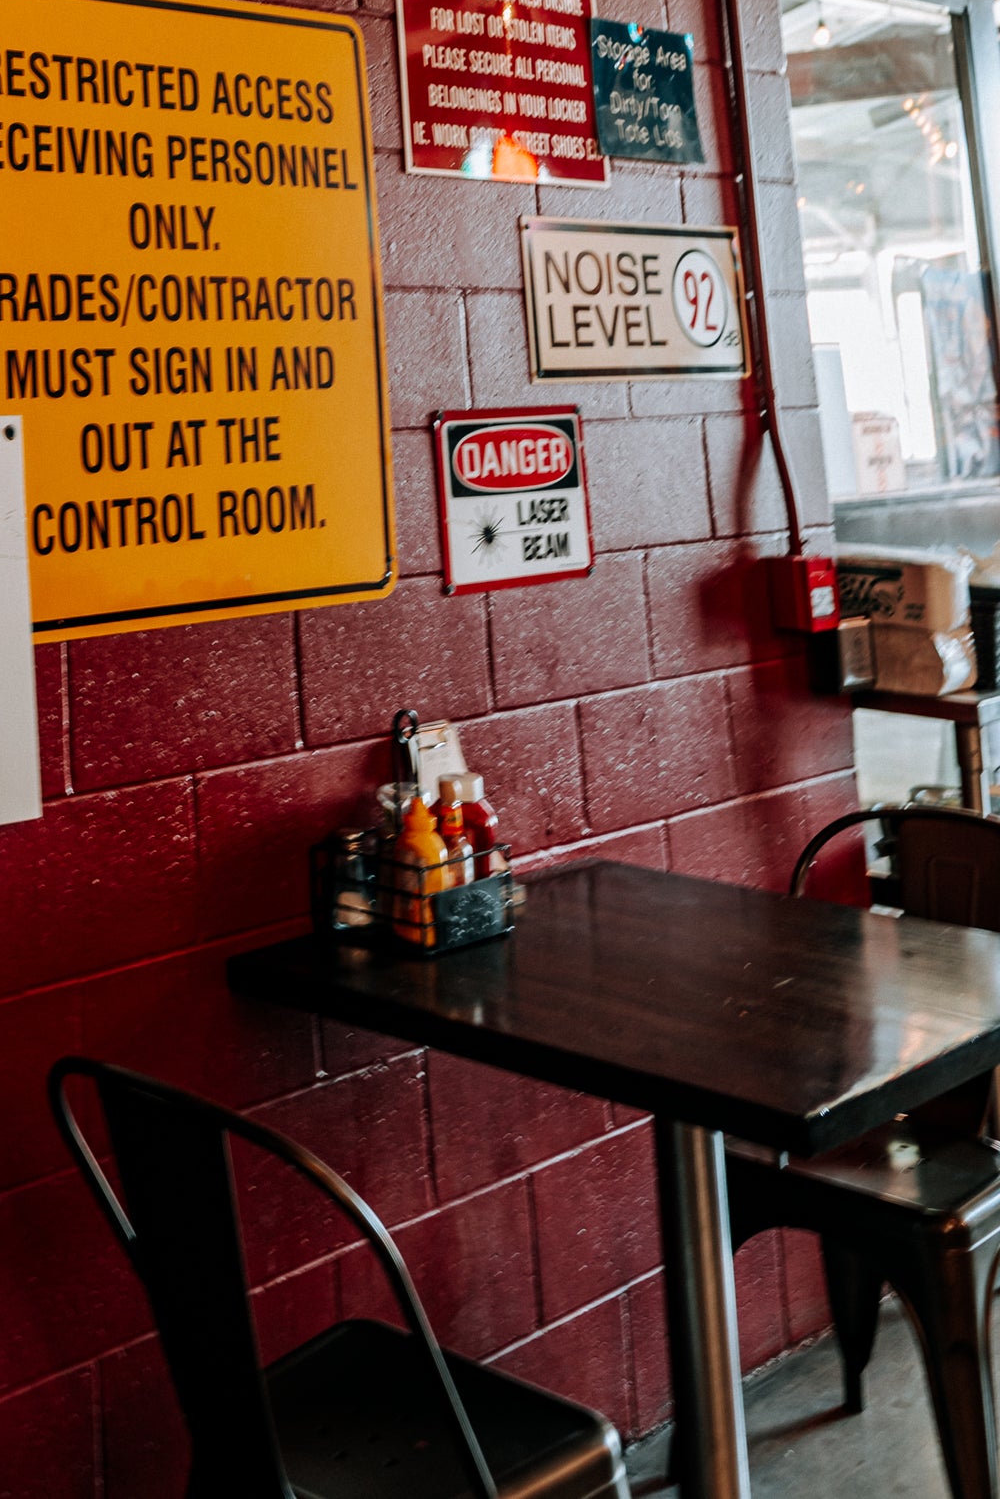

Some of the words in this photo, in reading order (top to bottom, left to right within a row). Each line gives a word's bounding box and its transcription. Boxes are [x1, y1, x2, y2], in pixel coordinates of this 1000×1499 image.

[430, 6, 455, 31] FOR
[456, 10, 486, 36] LOST
[487, 14, 505, 38] OR
[505, 18, 545, 44] STOLEN
[545, 22, 578, 51] ITEMS
[422, 43, 468, 72] PLEASE
[469, 50, 514, 78] SECURE
[514, 55, 535, 81] ALL
[535, 58, 588, 88] PERSONAL
[656, 45, 687, 72] Area
[212, 72, 334, 125] ACCESS
[427, 83, 503, 114] BELONGINGS
[503, 91, 518, 115] IN
[518, 93, 548, 119] YOUR
[548, 97, 588, 124] LOCKER
[167, 135, 358, 192] PERSONNEL
[431, 122, 469, 149] WORK
[551, 134, 586, 161] SHOES
[128, 202, 221, 252] ONLY.
[544, 250, 663, 296] NOISE
[684, 269, 718, 332] 92
[548, 304, 669, 349] LEVEL
[5, 348, 116, 400] MUST
[129, 347, 212, 396] SIGN
[225, 345, 256, 393] IN
[269, 345, 335, 391] AND
[80, 421, 154, 475] OUT
[165, 420, 207, 469] AT
[217, 416, 282, 465] THE
[461, 437, 569, 480] DANGER
[32, 492, 206, 557] CONTROL
[217, 484, 326, 539] ROOM.
[516, 498, 570, 527] LASER
[522, 532, 571, 562] BEAM
